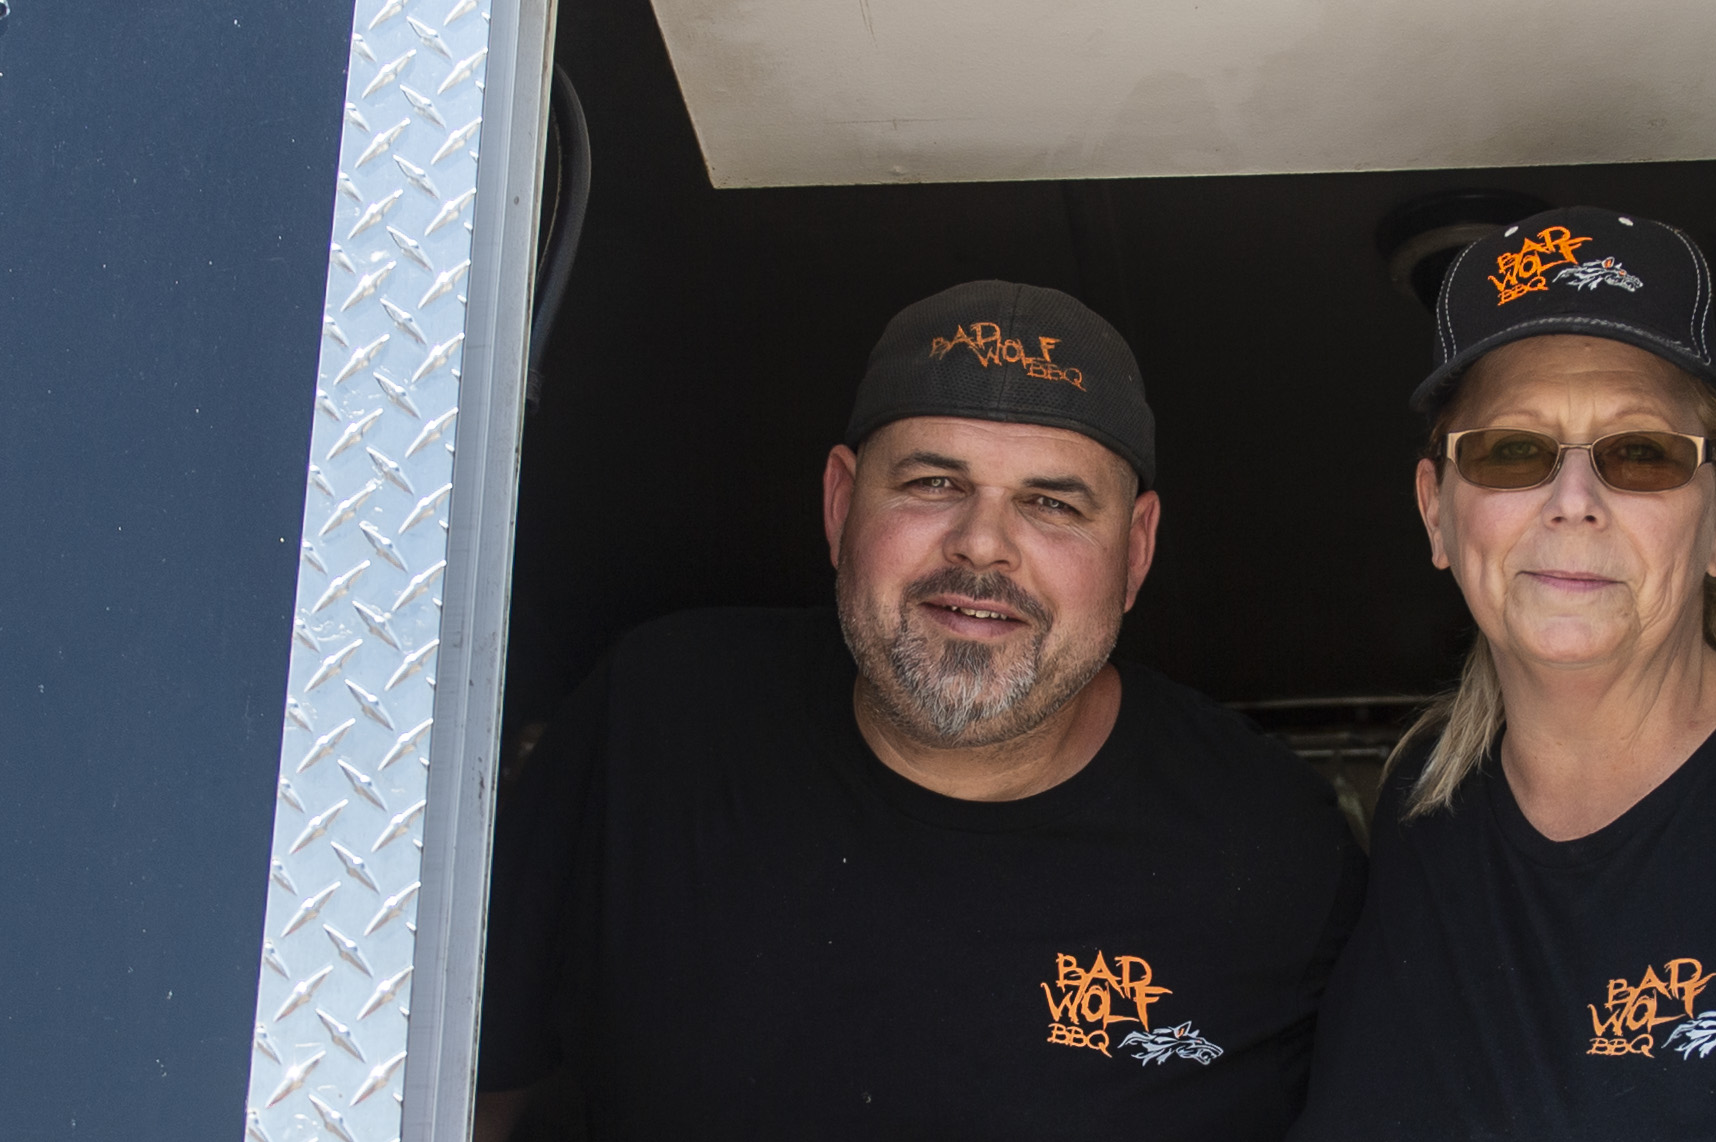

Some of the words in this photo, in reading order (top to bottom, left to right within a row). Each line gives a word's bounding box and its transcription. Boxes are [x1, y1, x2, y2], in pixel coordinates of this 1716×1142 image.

[1488, 236, 1593, 291] WOLF
[1497, 226, 1571, 275] BAD
[1497, 276, 1549, 306] BBQ
[929, 321, 1001, 361] BAD
[968, 335, 1062, 369] WOLF
[1027, 362, 1087, 392] BBQ
[1056, 950, 1152, 998] BAD
[1604, 958, 1702, 1011] BAD
[1041, 979, 1173, 1033] WOLF
[1047, 1023, 1112, 1058] BBQ
[1586, 1034, 1655, 1059] BBQ
